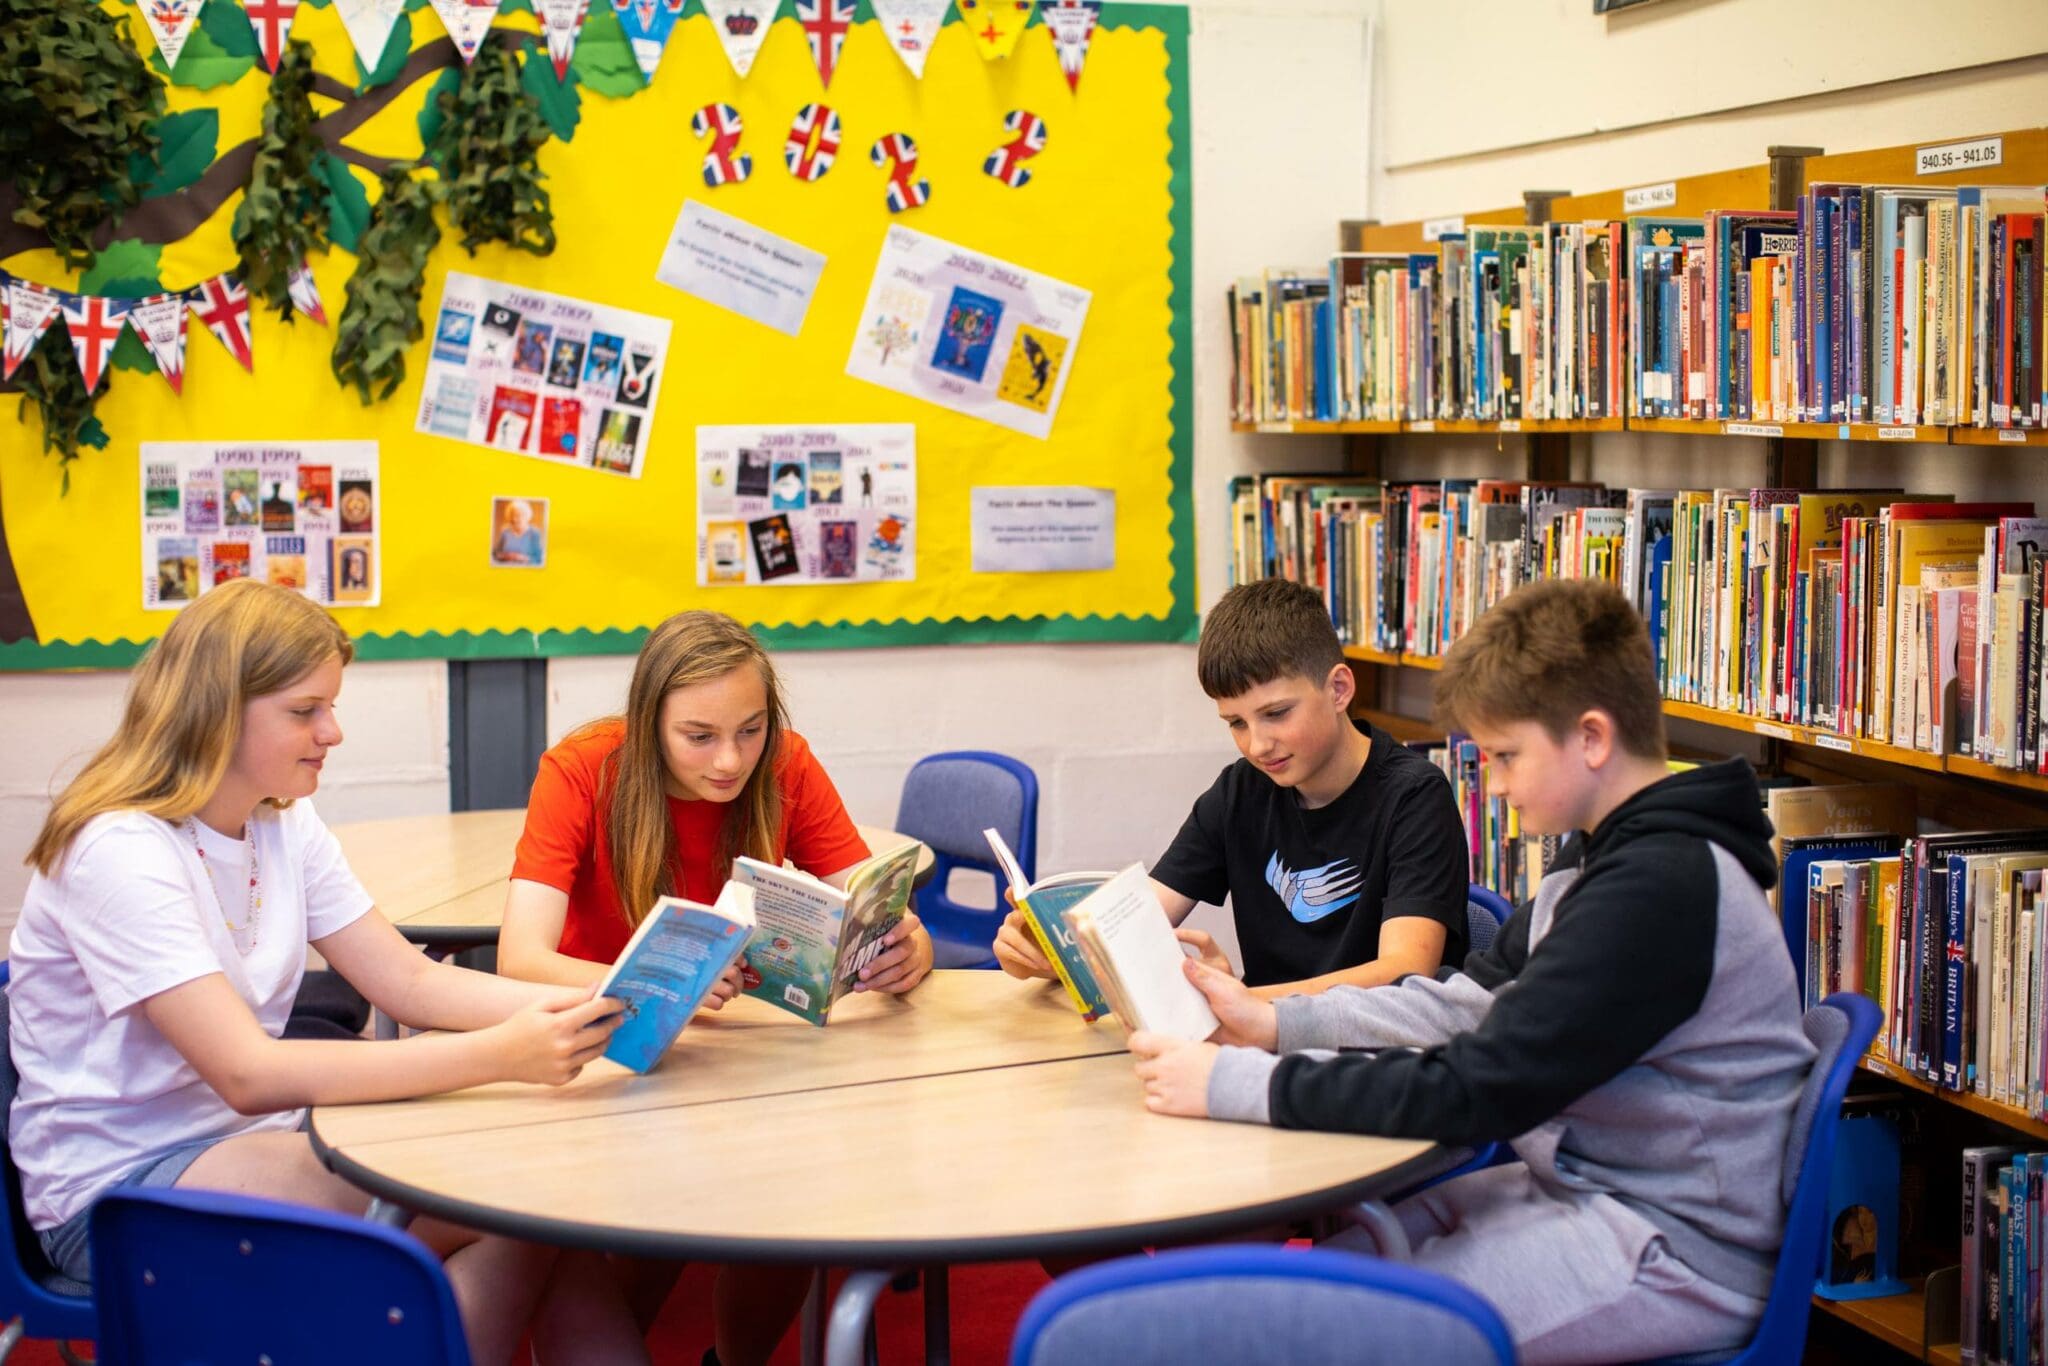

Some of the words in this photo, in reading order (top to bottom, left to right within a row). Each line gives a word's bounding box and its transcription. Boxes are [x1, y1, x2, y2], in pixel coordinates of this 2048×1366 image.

[1922, 152, 1953, 169] 940.56
[1964, 146, 1996, 163] 941.05
[1816, 209, 1824, 245] BRITISH
[1815, 248, 1826, 276] Kings
[1815, 285, 1827, 324] Queens
[1882, 275, 1890, 314] ROYAL
[215, 450, 254, 464] 1990
[262, 449, 302, 463] 1999
[1900, 603, 1912, 672] Plantagenets
[1824, 801, 1872, 818] Years
[1825, 824, 1839, 834] of
[752, 875, 768, 886] THE
[768, 879, 789, 891] SKY'S
[791, 888, 806, 899] THE
[807, 894, 829, 906] LIMIT
[1949, 869, 1961, 936] Yesterday's
[1946, 967, 1957, 1033] BRITAIN
[1964, 1160, 1976, 1236] FIFTIES
[2013, 1193, 2023, 1239] COAST
[1990, 1274, 1999, 1320] 1980s
